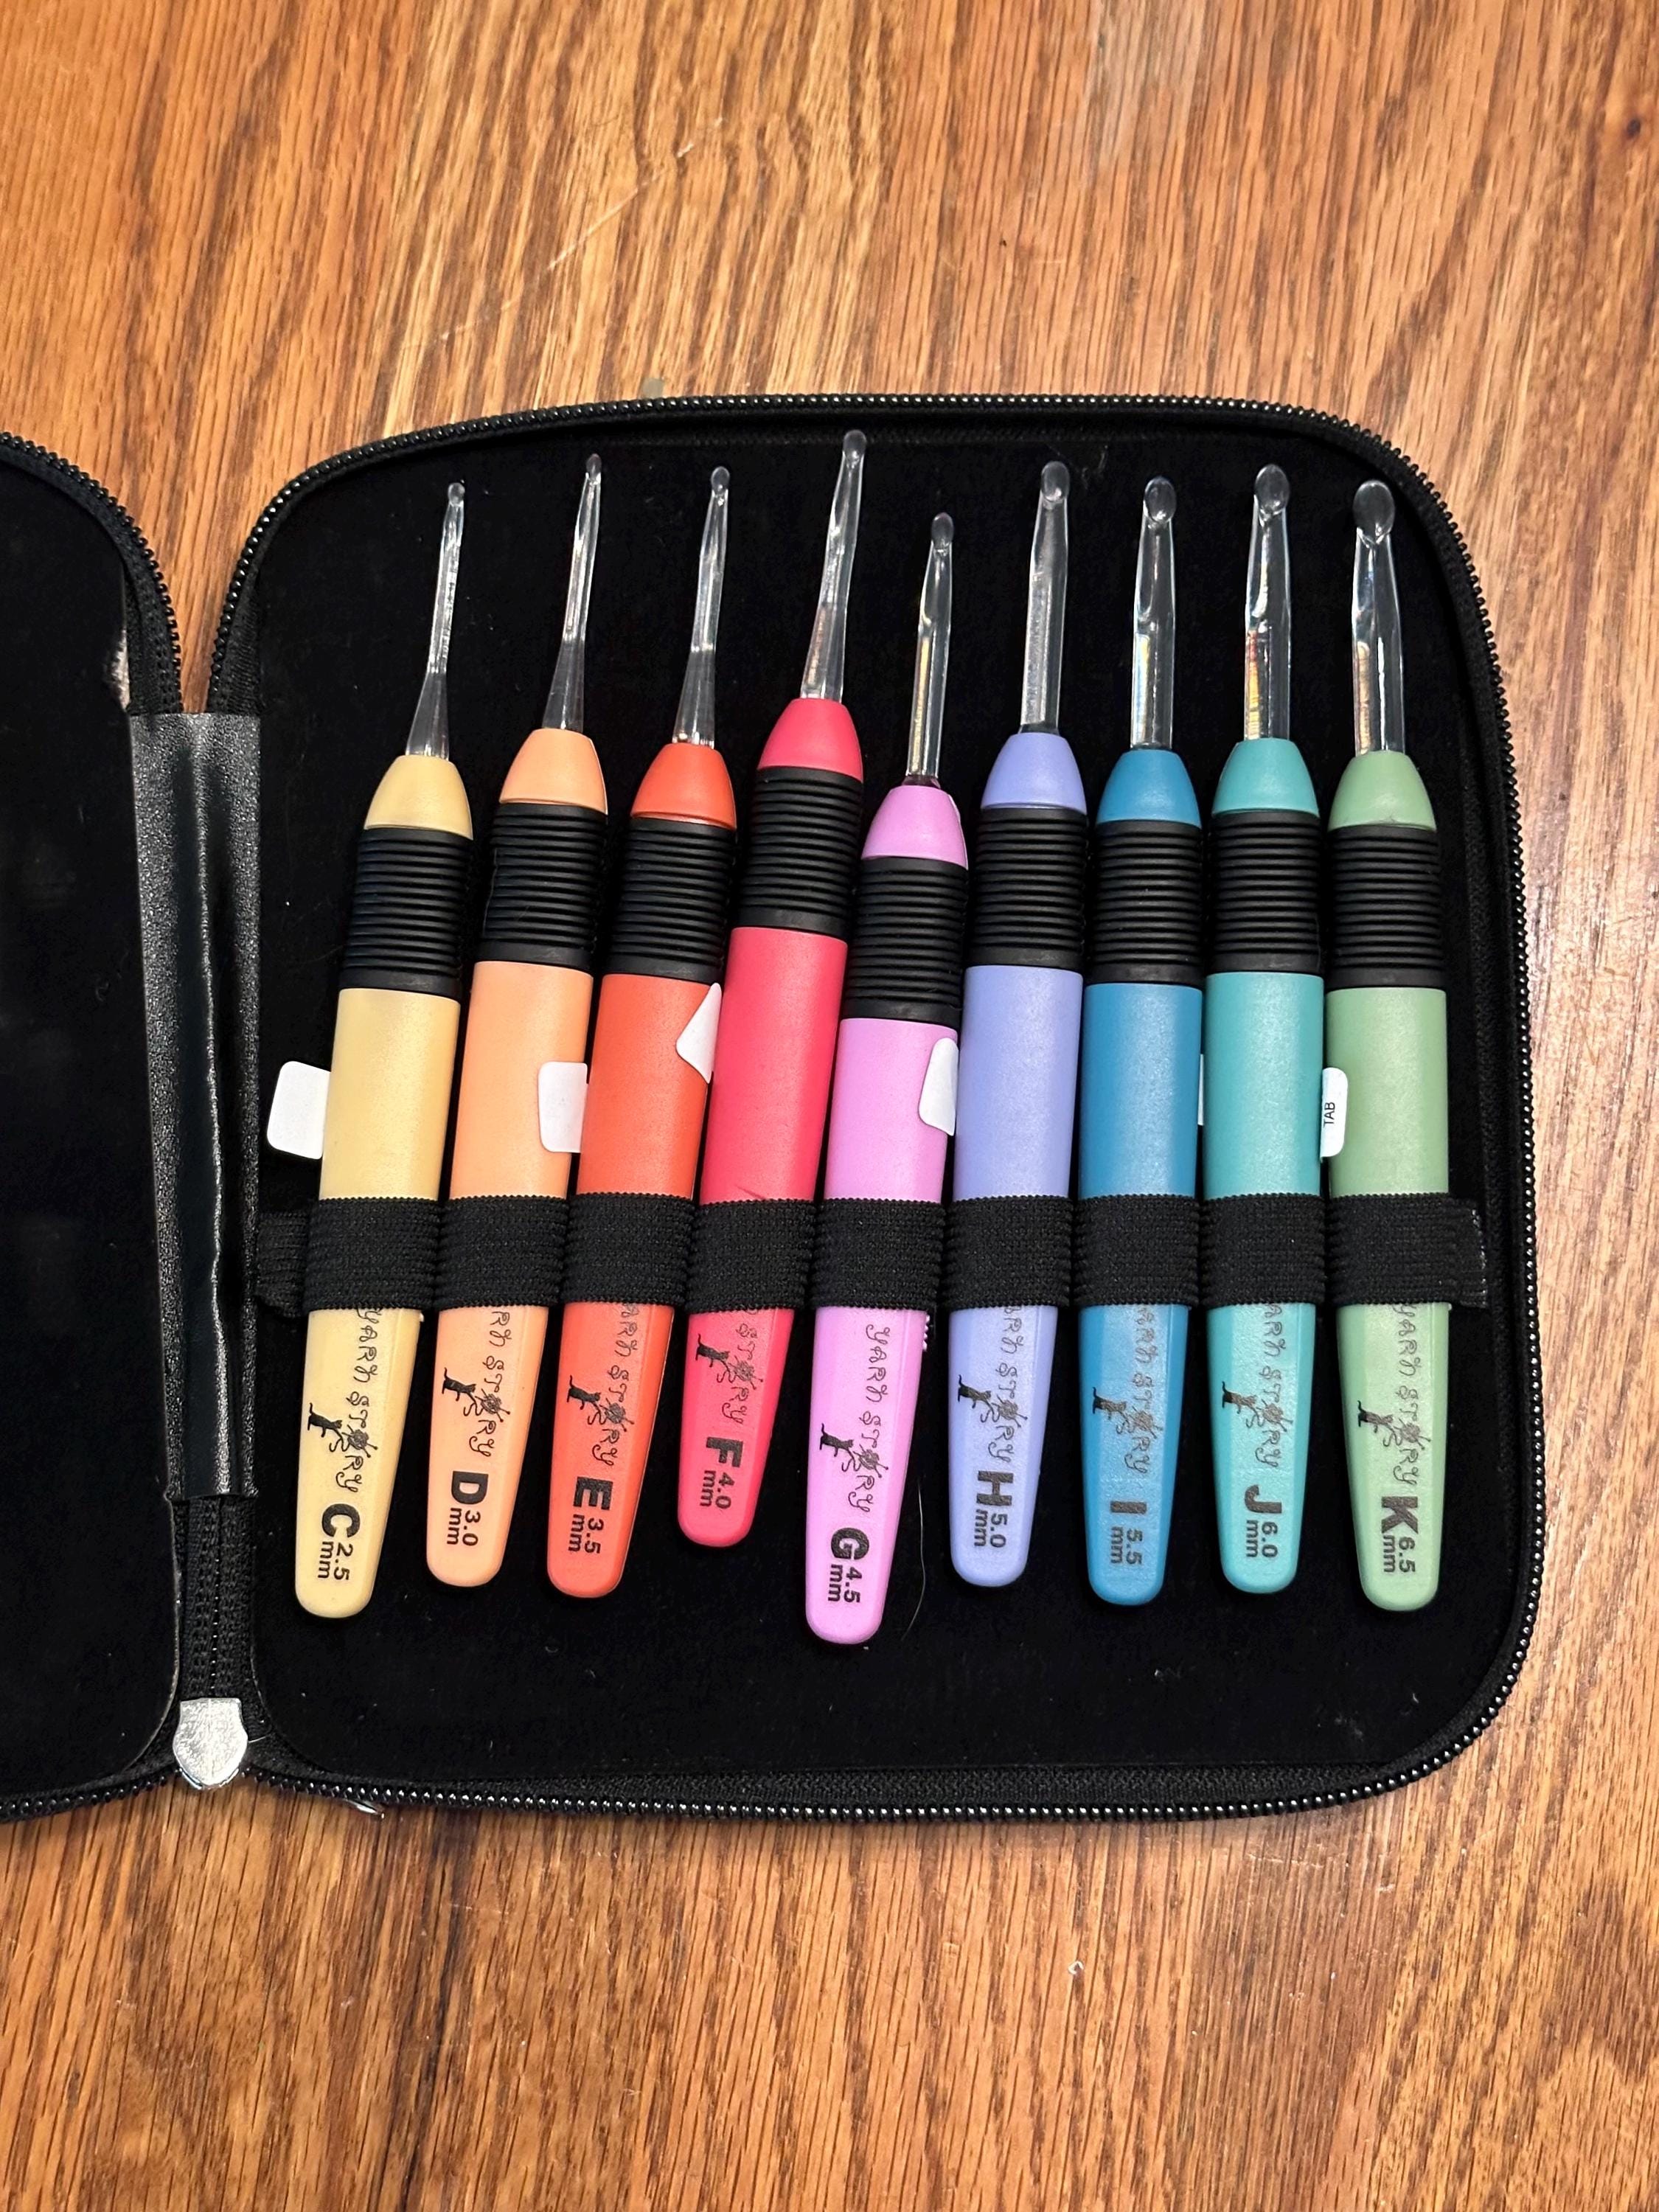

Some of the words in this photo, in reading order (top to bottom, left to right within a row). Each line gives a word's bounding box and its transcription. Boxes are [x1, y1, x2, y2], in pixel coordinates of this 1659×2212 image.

[1324, 1102, 1335, 1127] TAB
[706, 1436, 744, 1468] F
[451, 1470, 488, 1505] D
[573, 1476, 613, 1511] E
[699, 1470, 717, 1507] mm
[714, 1472, 736, 1510] 4.0
[977, 1470, 1014, 1507] H
[1244, 1484, 1282, 1514] J
[321, 1503, 361, 1538] C
[446, 1507, 462, 1545] mm
[1110, 1501, 1147, 1514] I
[1380, 1496, 1418, 1536] K
[462, 1509, 481, 1546] 3.0
[568, 1514, 585, 1552] mm
[584, 1517, 604, 1554] 3.5
[830, 1527, 870, 1561] G
[973, 1509, 989, 1547] mm
[989, 1512, 1008, 1548] 5.0
[1110, 1526, 1124, 1564] mm
[1245, 1520, 1259, 1558] mm
[1261, 1521, 1279, 1559] 6.0
[317, 1541, 334, 1579] mm
[333, 1543, 354, 1581] 2.5
[1125, 1528, 1144, 1566] 5.5
[1382, 1535, 1396, 1573] mm
[1398, 1536, 1416, 1573] 6.5
[827, 1563, 844, 1602] mm
[844, 1565, 863, 1604] 4.5
